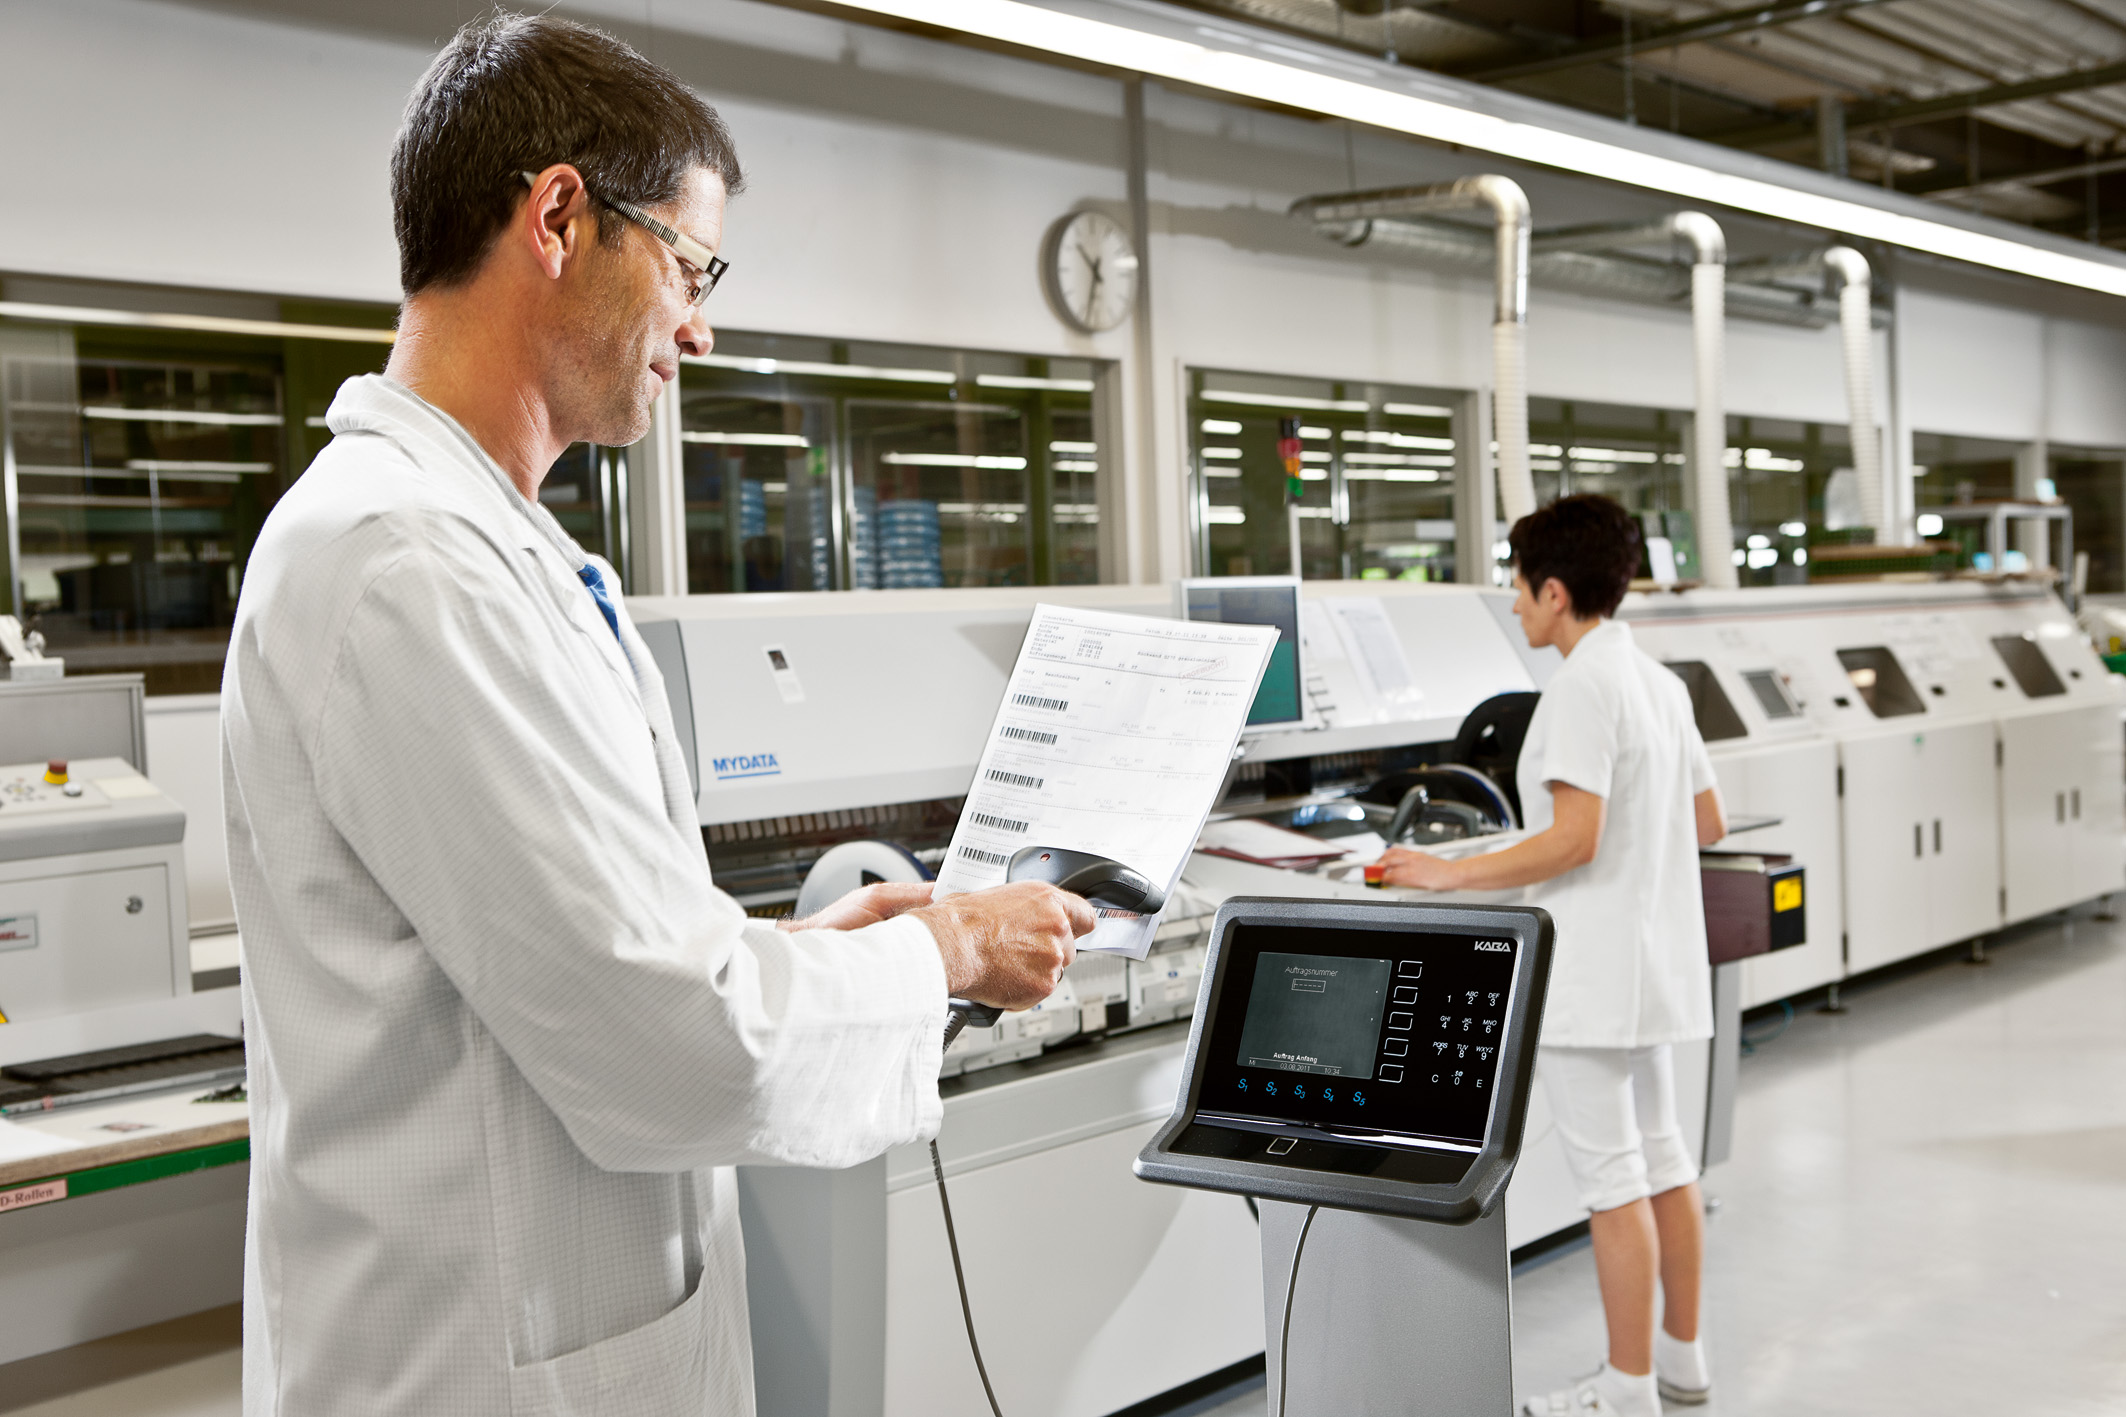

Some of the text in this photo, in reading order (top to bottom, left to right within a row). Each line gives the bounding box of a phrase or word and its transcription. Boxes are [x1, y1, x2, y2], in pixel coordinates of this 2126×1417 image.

[712, 753, 778, 772] MYDATA
[1474, 940, 1511, 952] KABA
[1285, 966, 1338, 977] Auftragsnummer
[1447, 994, 1496, 1006] 1 2 3
[1441, 1021, 1491, 1034] 4 5 6
[1432, 1041, 1448, 1049] PQRS
[1456, 1043, 1469, 1051] TUV
[1273, 1052, 1318, 1064] Auftrag Anfang
[1437, 1048, 1487, 1061] 7 8 9
[1432, 1074, 1439, 1083] C
[1476, 1079, 1483, 1088] E
[1454, 1077, 1460, 1085] 0
[1266, 1081, 1277, 1095] S2
[1294, 1084, 1306, 1099] S3
[1323, 1088, 1334, 1102] S4
[1353, 1091, 1366, 1106] S5
[0, 1188, 54, 1207] D-Rollen
